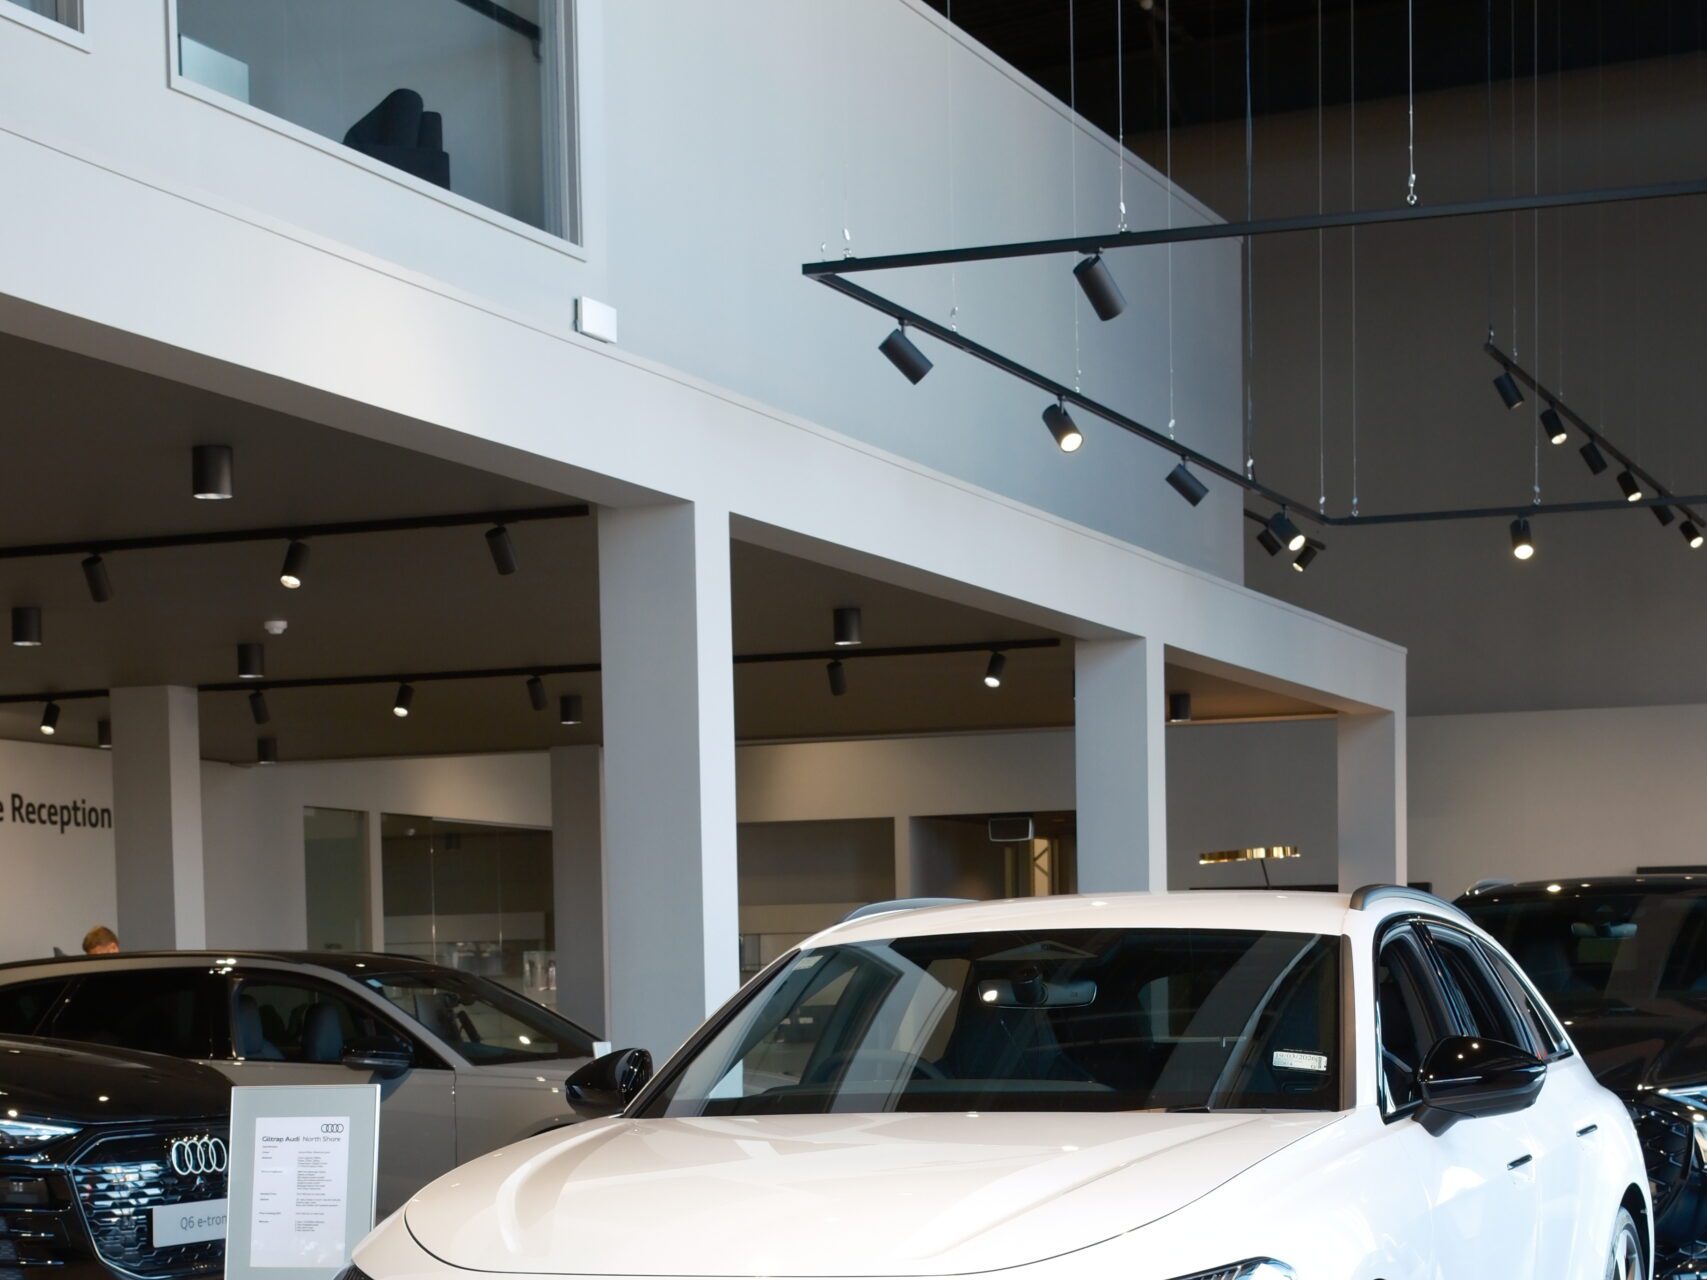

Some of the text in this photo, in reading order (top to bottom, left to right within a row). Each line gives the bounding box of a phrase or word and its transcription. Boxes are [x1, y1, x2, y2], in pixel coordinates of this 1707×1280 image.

[11, 793, 112, 834] Reception
[180, 1215, 227, 1230] Q6 e-tron
